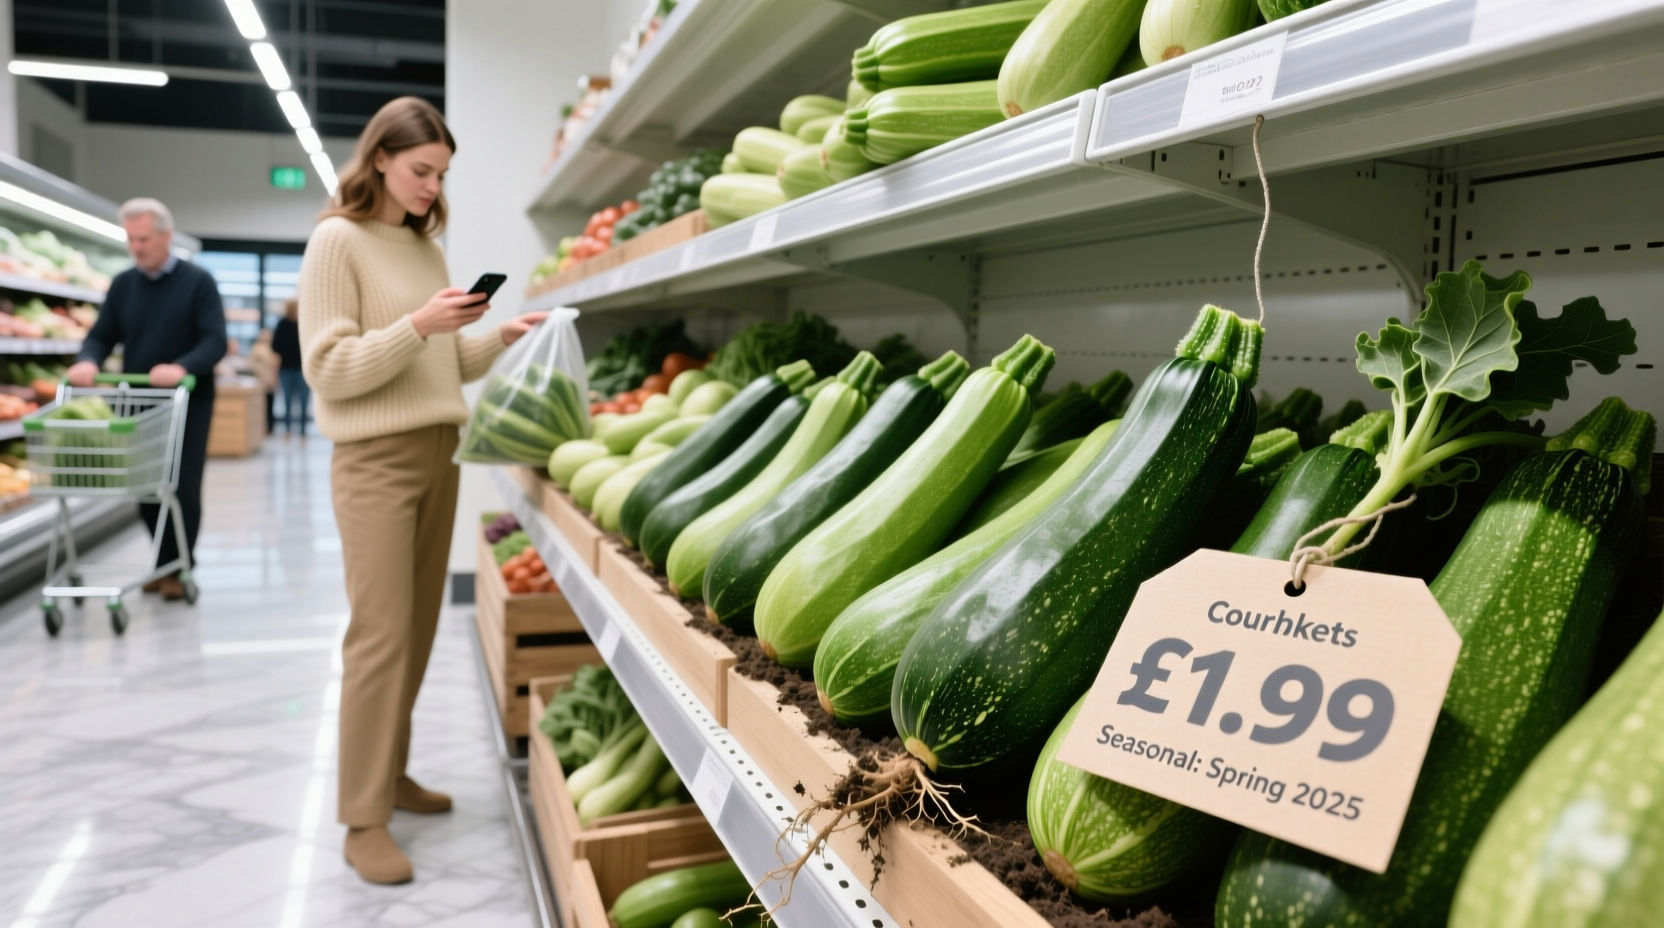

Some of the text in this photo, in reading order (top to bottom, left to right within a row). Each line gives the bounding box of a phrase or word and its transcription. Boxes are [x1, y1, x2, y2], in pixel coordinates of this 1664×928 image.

[1207, 600, 1358, 648] Courhkets
[1116, 637, 1395, 763] £1.99
[1096, 724, 1364, 820] Seasonal: Spring 2025
